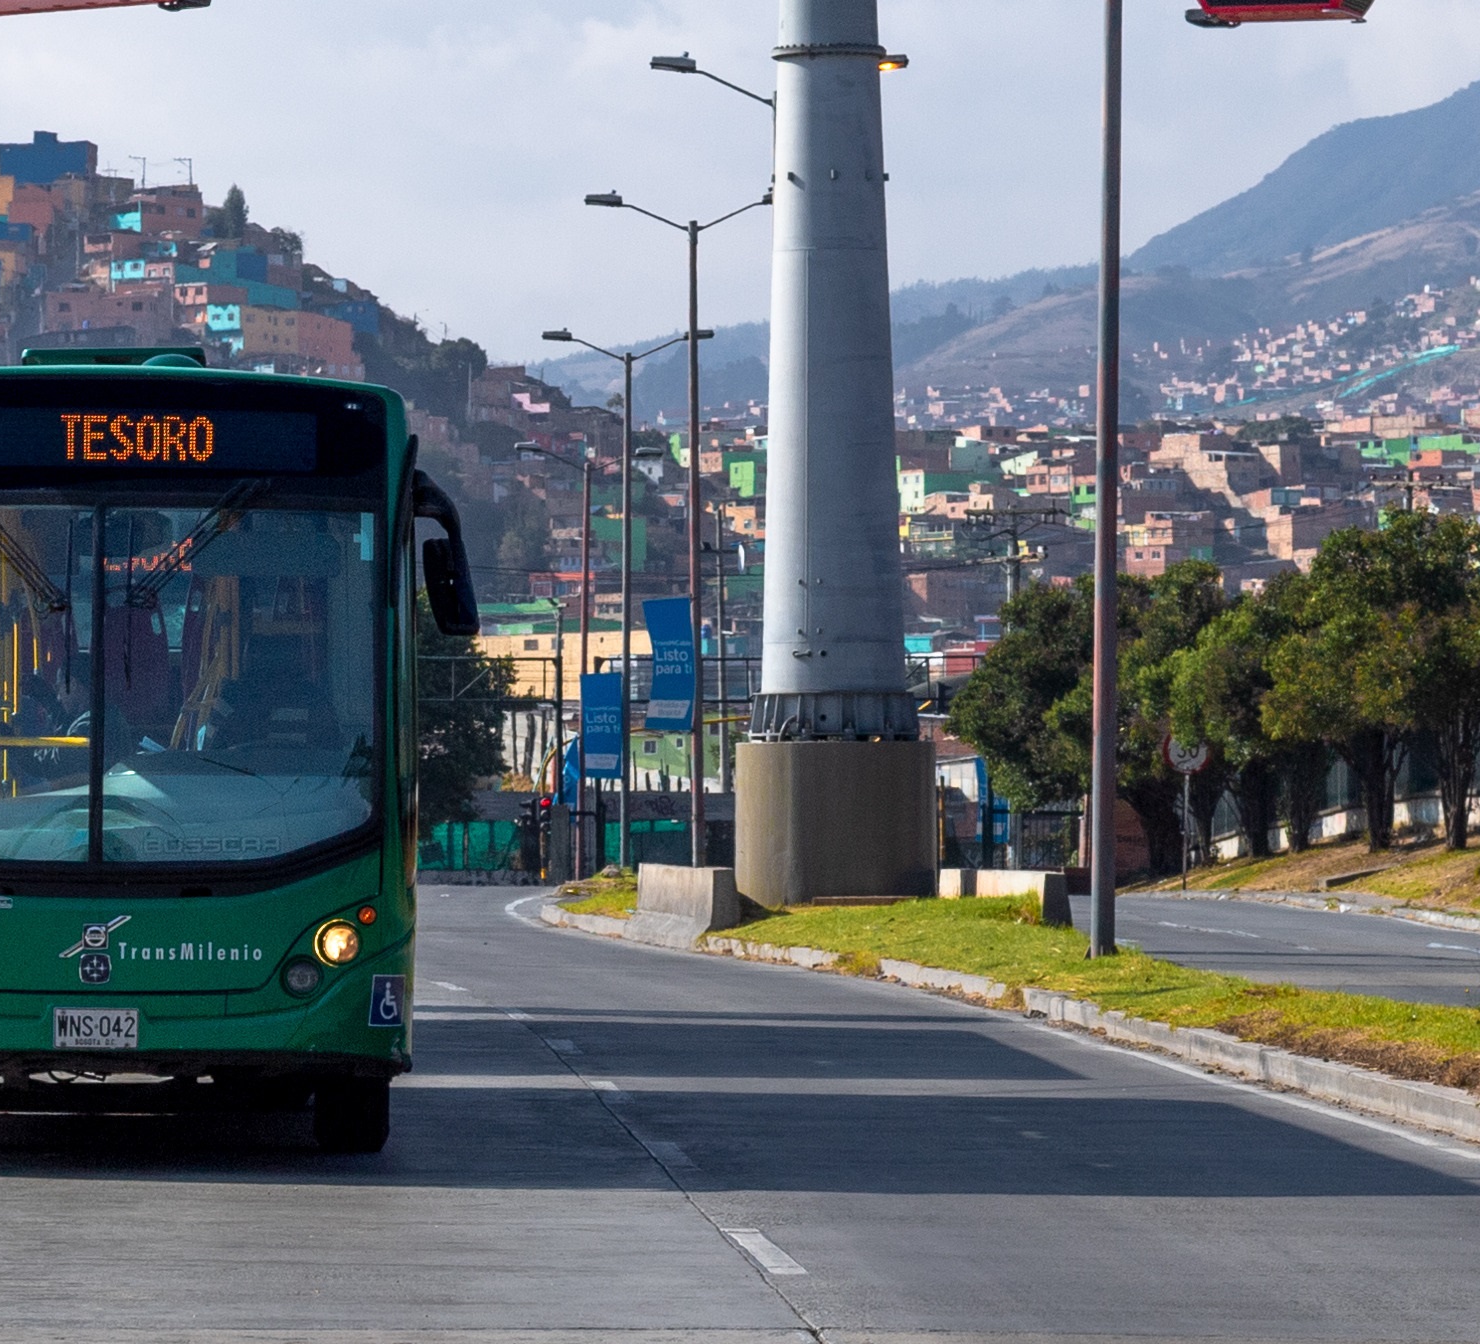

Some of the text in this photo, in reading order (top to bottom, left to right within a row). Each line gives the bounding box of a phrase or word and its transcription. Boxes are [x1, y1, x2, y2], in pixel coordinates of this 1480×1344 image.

[60, 414, 214, 461] TESORO
[655, 648, 689, 662] Listo
[655, 662, 693, 677] para ti
[585, 712, 617, 724] Listo
[586, 724, 611, 735] para
[118, 942, 263, 960] TransMilenio
